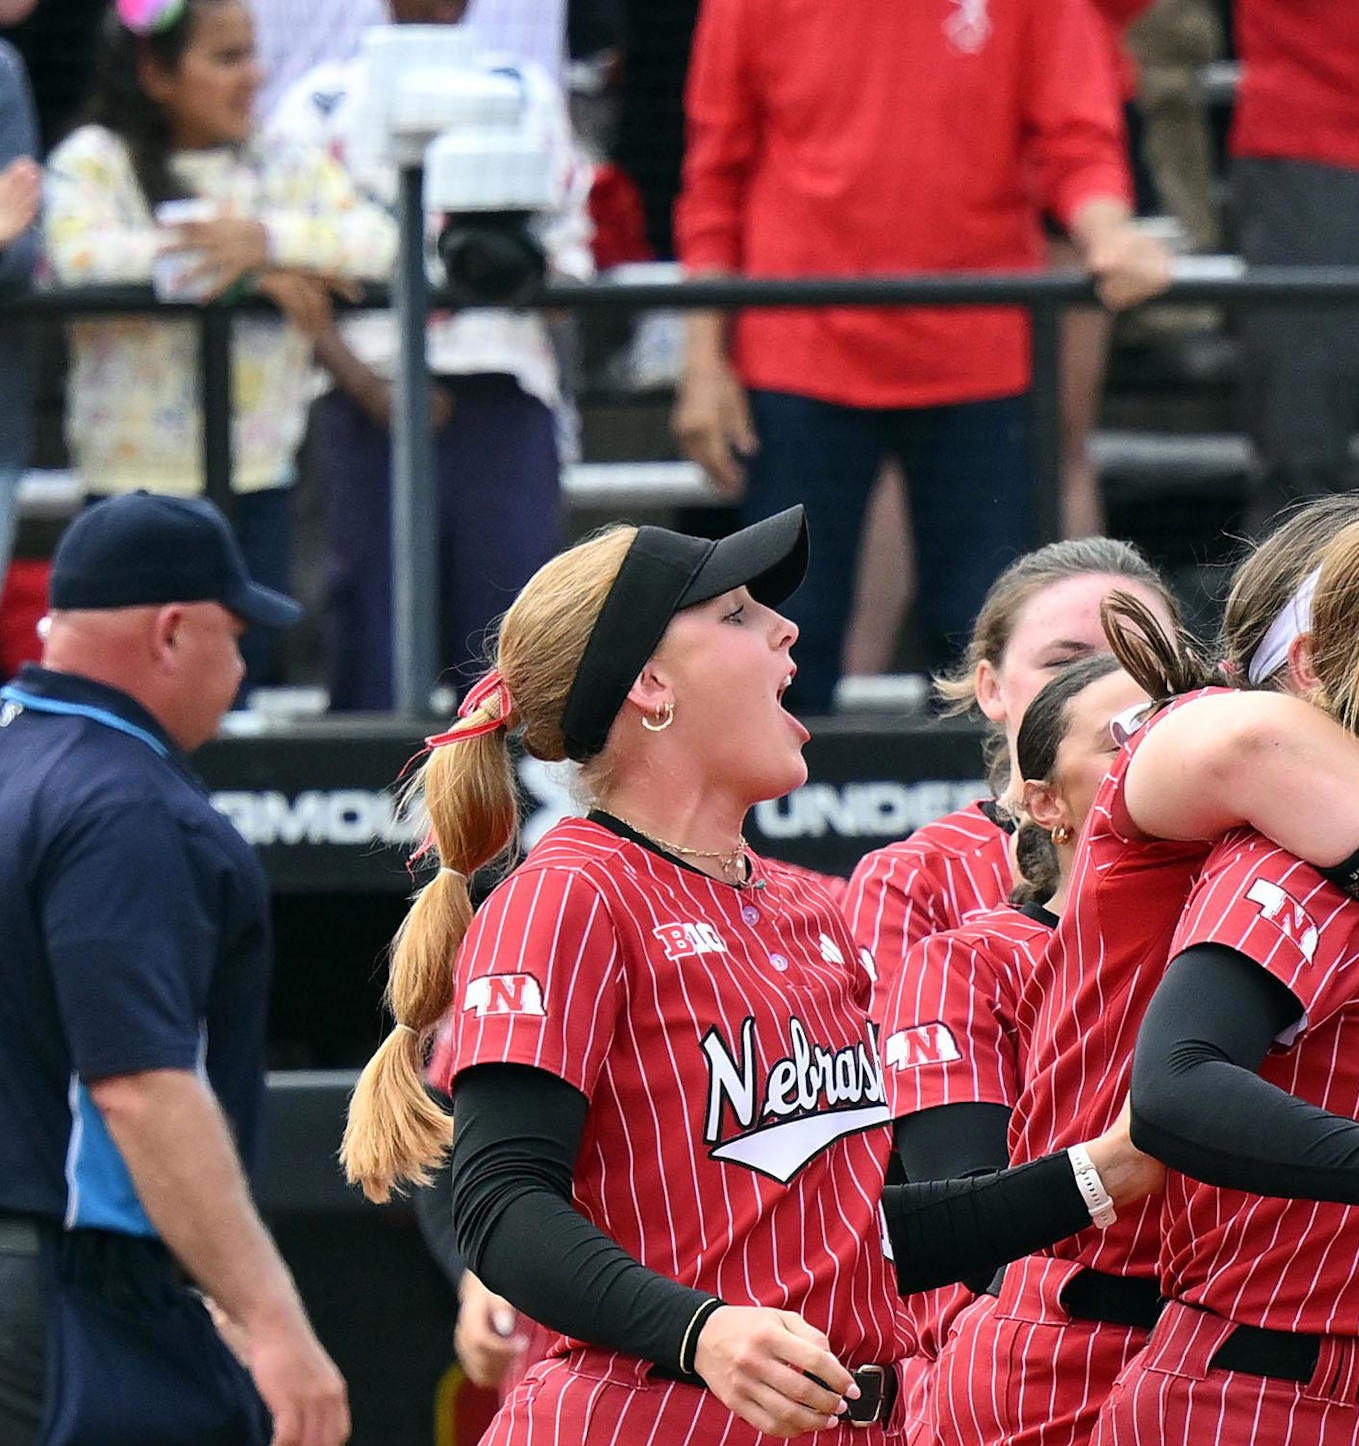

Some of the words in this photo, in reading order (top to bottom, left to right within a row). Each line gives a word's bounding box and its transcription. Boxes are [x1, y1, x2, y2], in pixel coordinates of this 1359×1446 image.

[652, 922, 728, 961] BIG
[1271, 894, 1318, 950] N
[486, 976, 526, 1014] N
[905, 1024, 942, 1067] N
